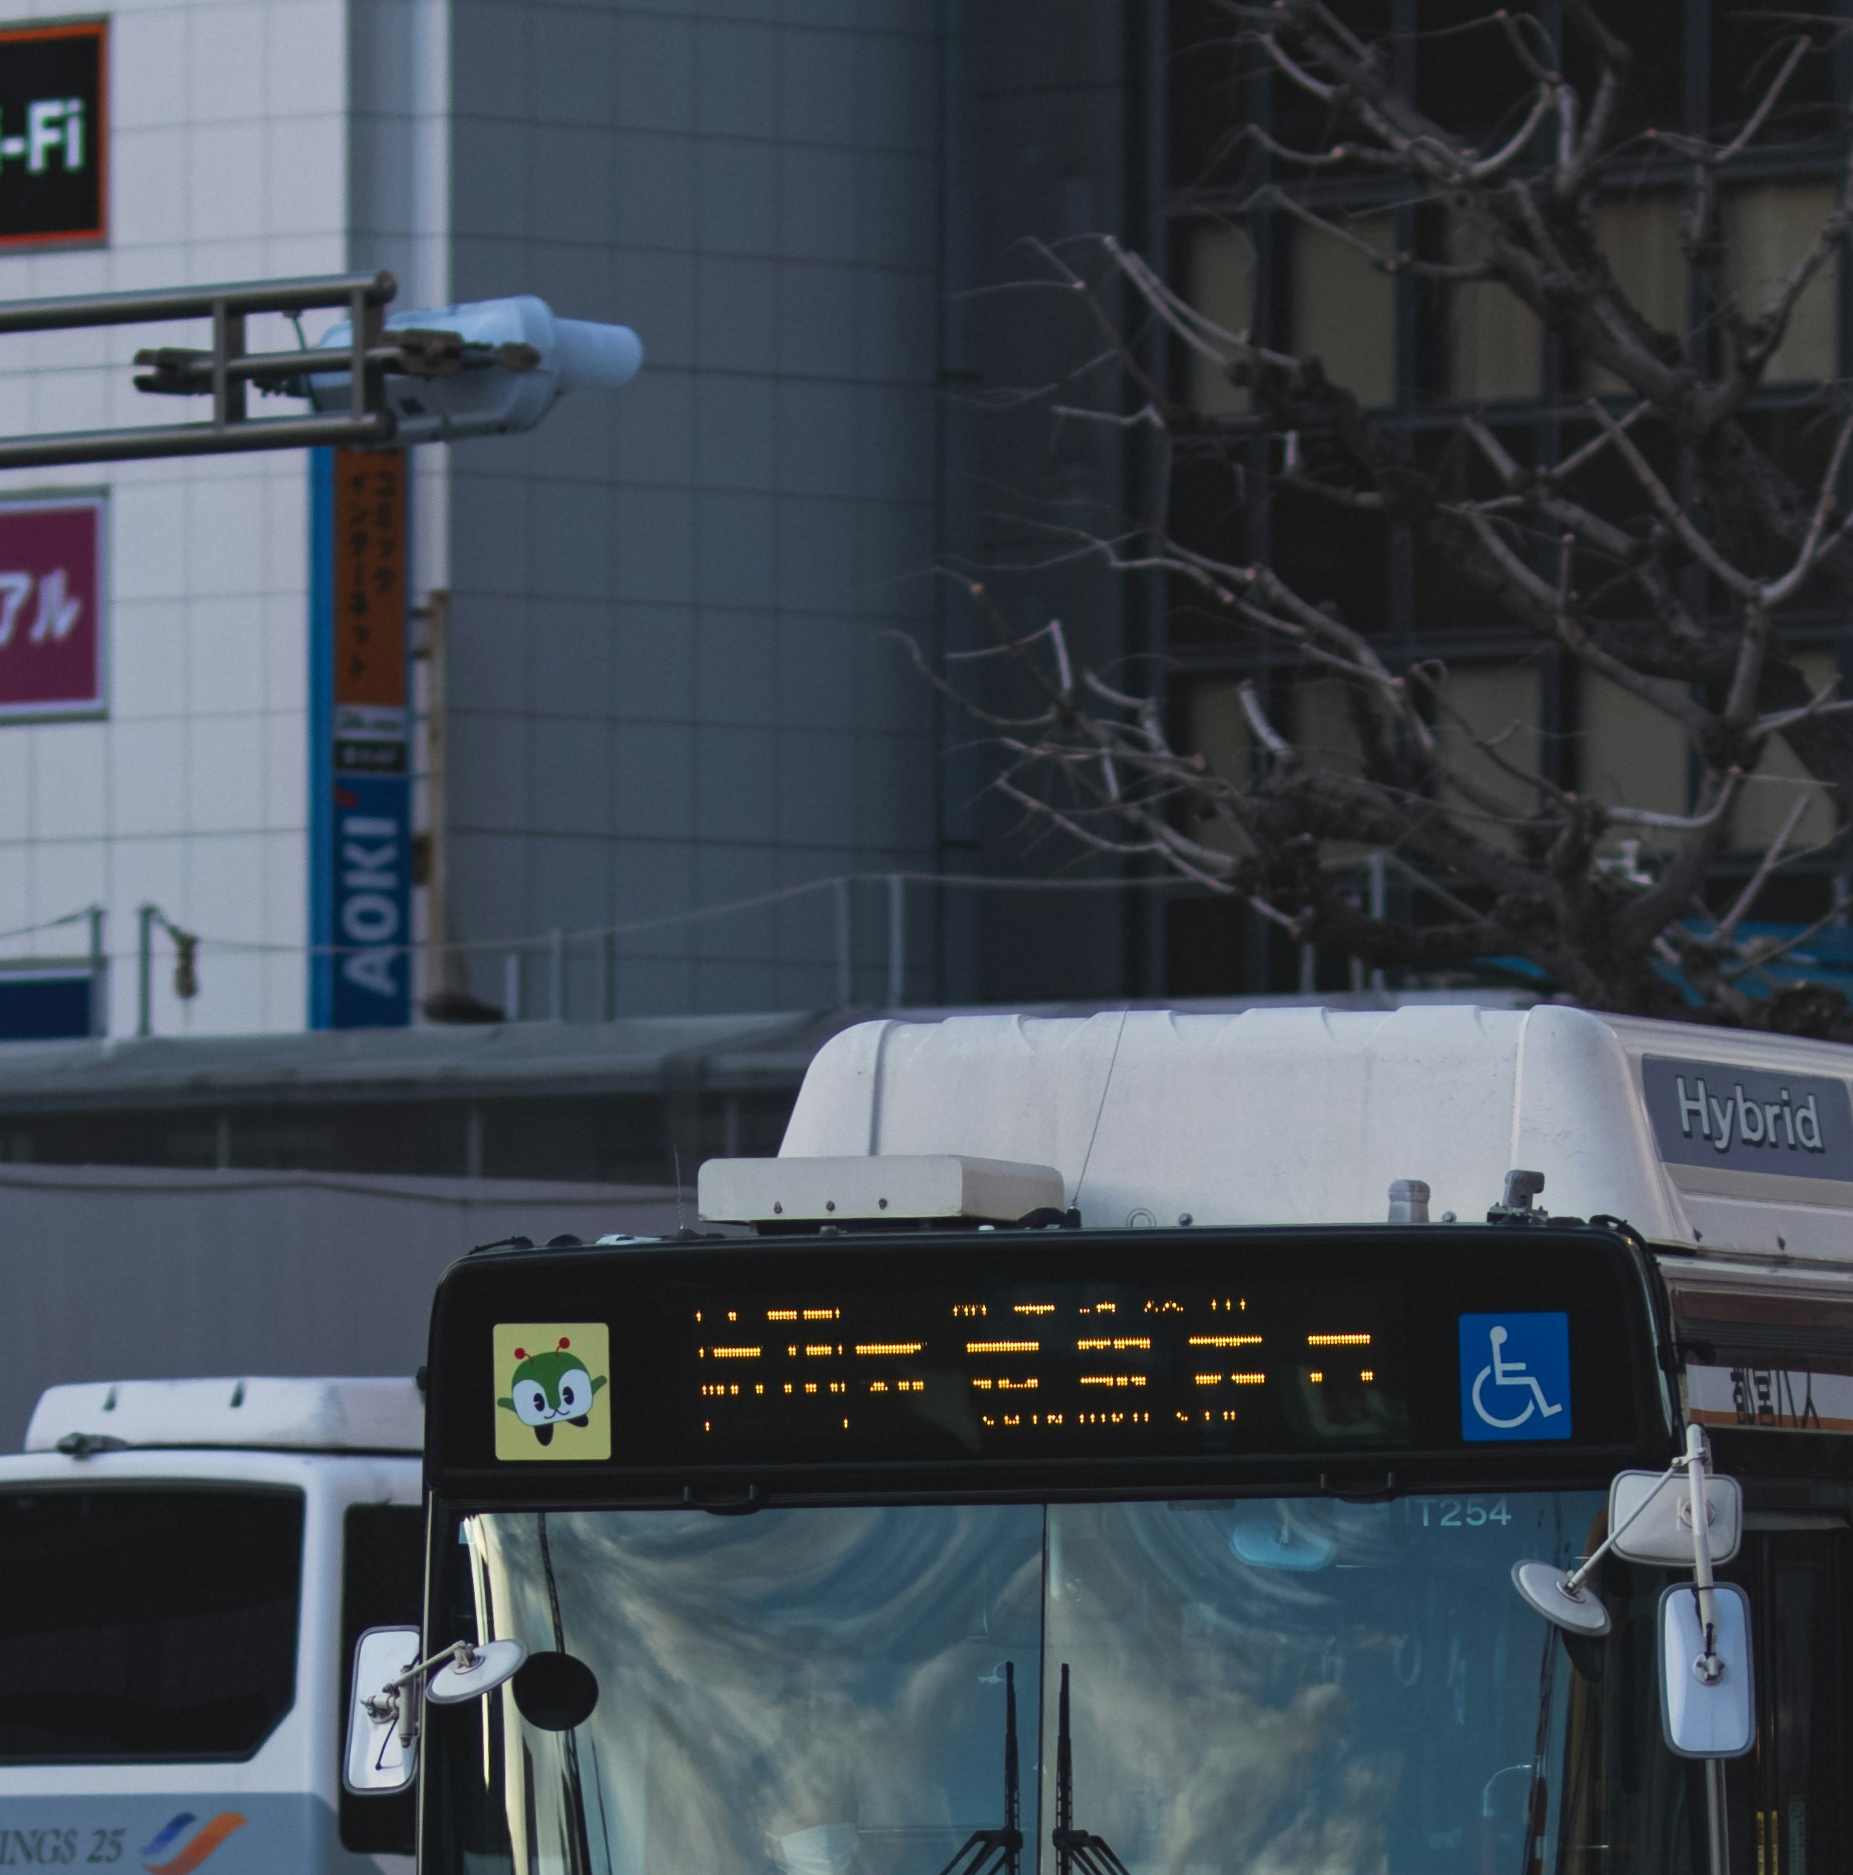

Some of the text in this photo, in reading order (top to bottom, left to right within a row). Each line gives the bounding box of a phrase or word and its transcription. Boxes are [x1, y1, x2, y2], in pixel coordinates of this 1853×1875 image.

[341, 815, 400, 997] AOKI
[1675, 1075, 1827, 1153] Hybrid
[1412, 1494, 1513, 1528] T254
[85, 1827, 128, 1864] 25
